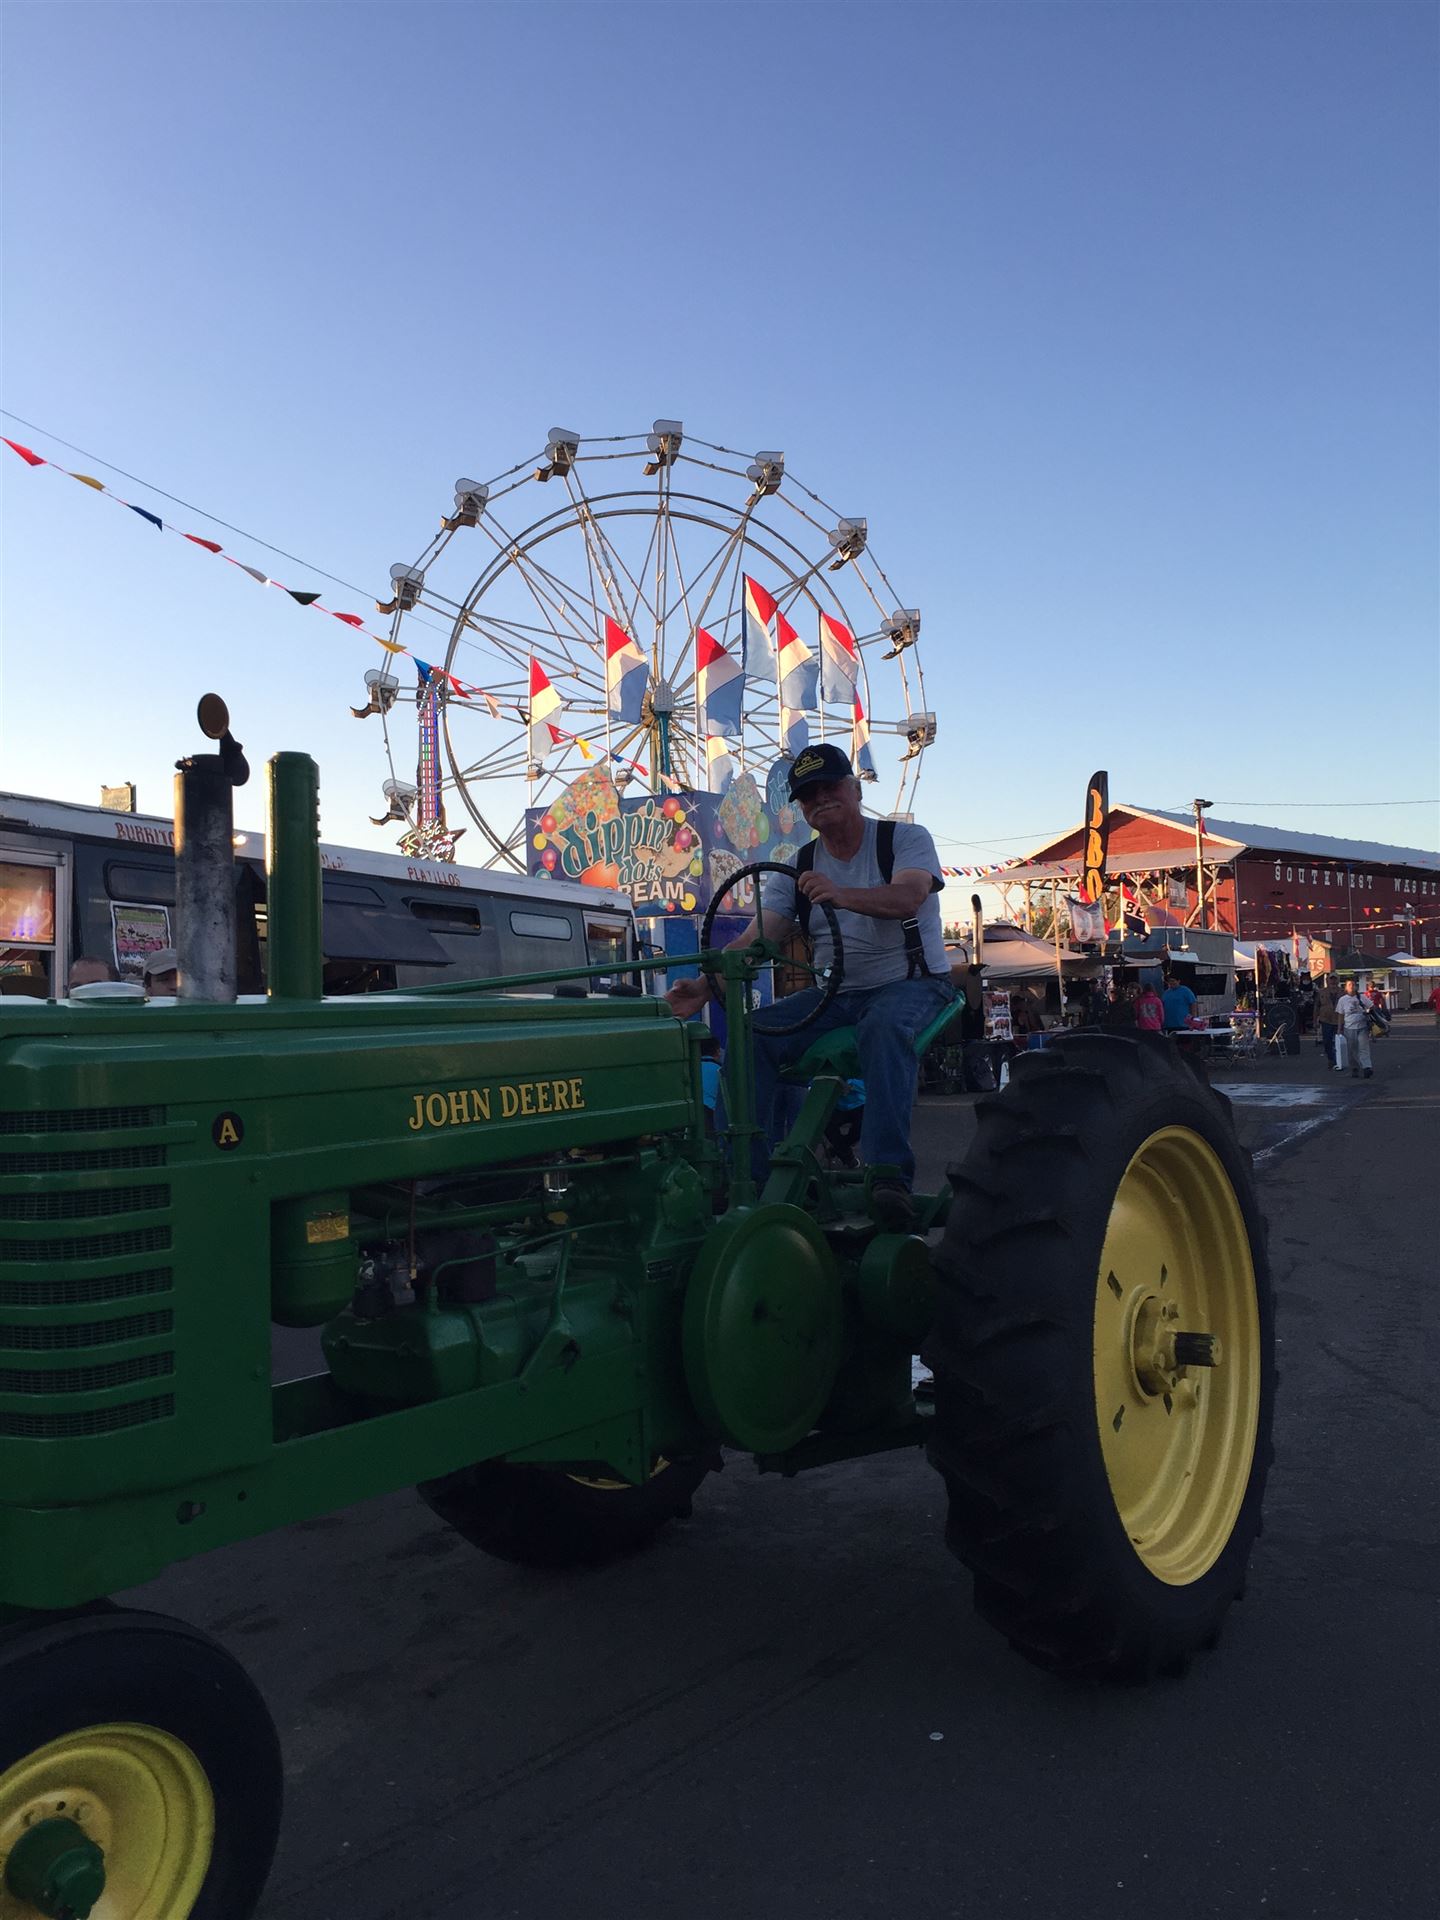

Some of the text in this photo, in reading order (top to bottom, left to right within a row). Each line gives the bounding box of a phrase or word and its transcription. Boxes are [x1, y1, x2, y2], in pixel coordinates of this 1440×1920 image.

[1274, 865, 1373, 889] SOUTHWEST
[605, 880, 685, 902] REAM
[408, 1078, 585, 1130] JOHN DEERE
[219, 1118, 239, 1145] A
